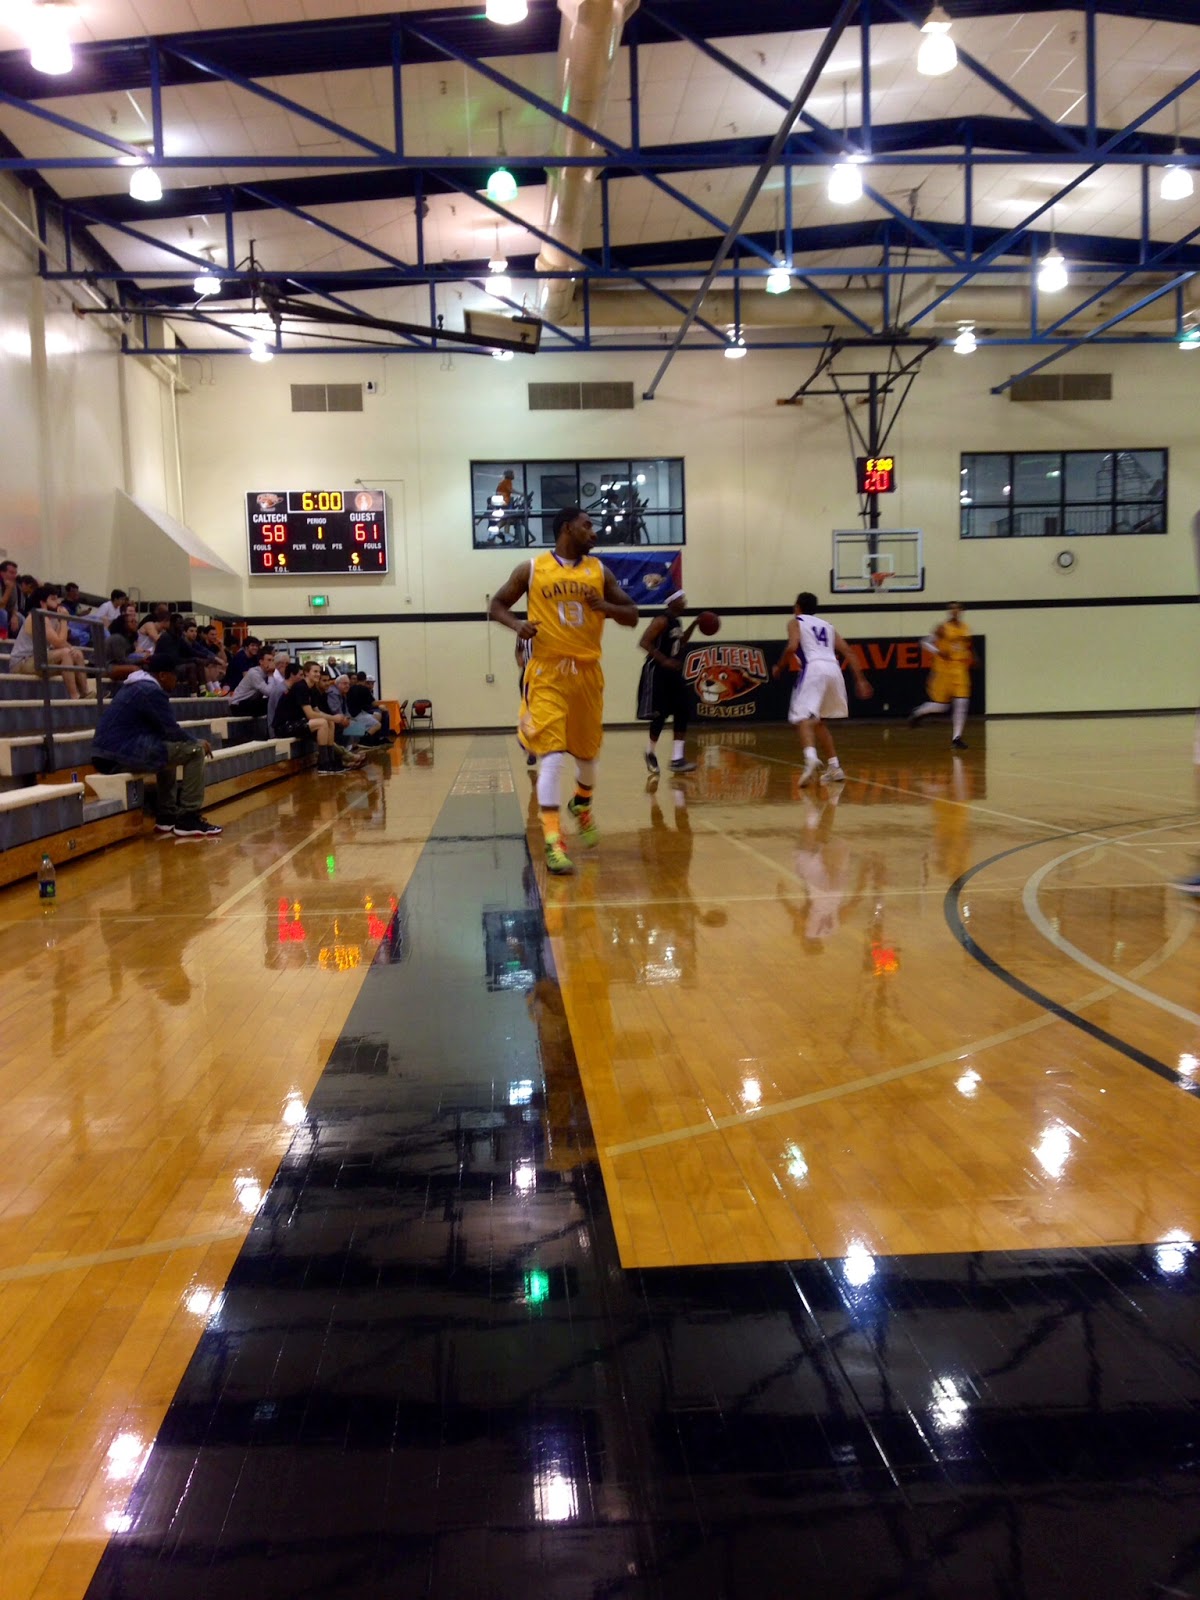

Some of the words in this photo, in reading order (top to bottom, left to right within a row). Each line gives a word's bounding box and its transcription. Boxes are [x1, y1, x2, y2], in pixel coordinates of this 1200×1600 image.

[864, 470, 889, 490] 20
[302, 492, 341, 511] 6:00
[252, 513, 288, 523] CALTECH
[306, 517, 327, 525] PERIOD
[349, 512, 376, 522] GUEST
[262, 524, 285, 543] 58
[355, 523, 378, 541] 61
[263, 552, 273, 567] 0
[557, 601, 583, 627] 13
[812, 626, 829, 647] 14
[684, 646, 767, 681] CALTECH
[697, 702, 756, 718] BEAVERS
